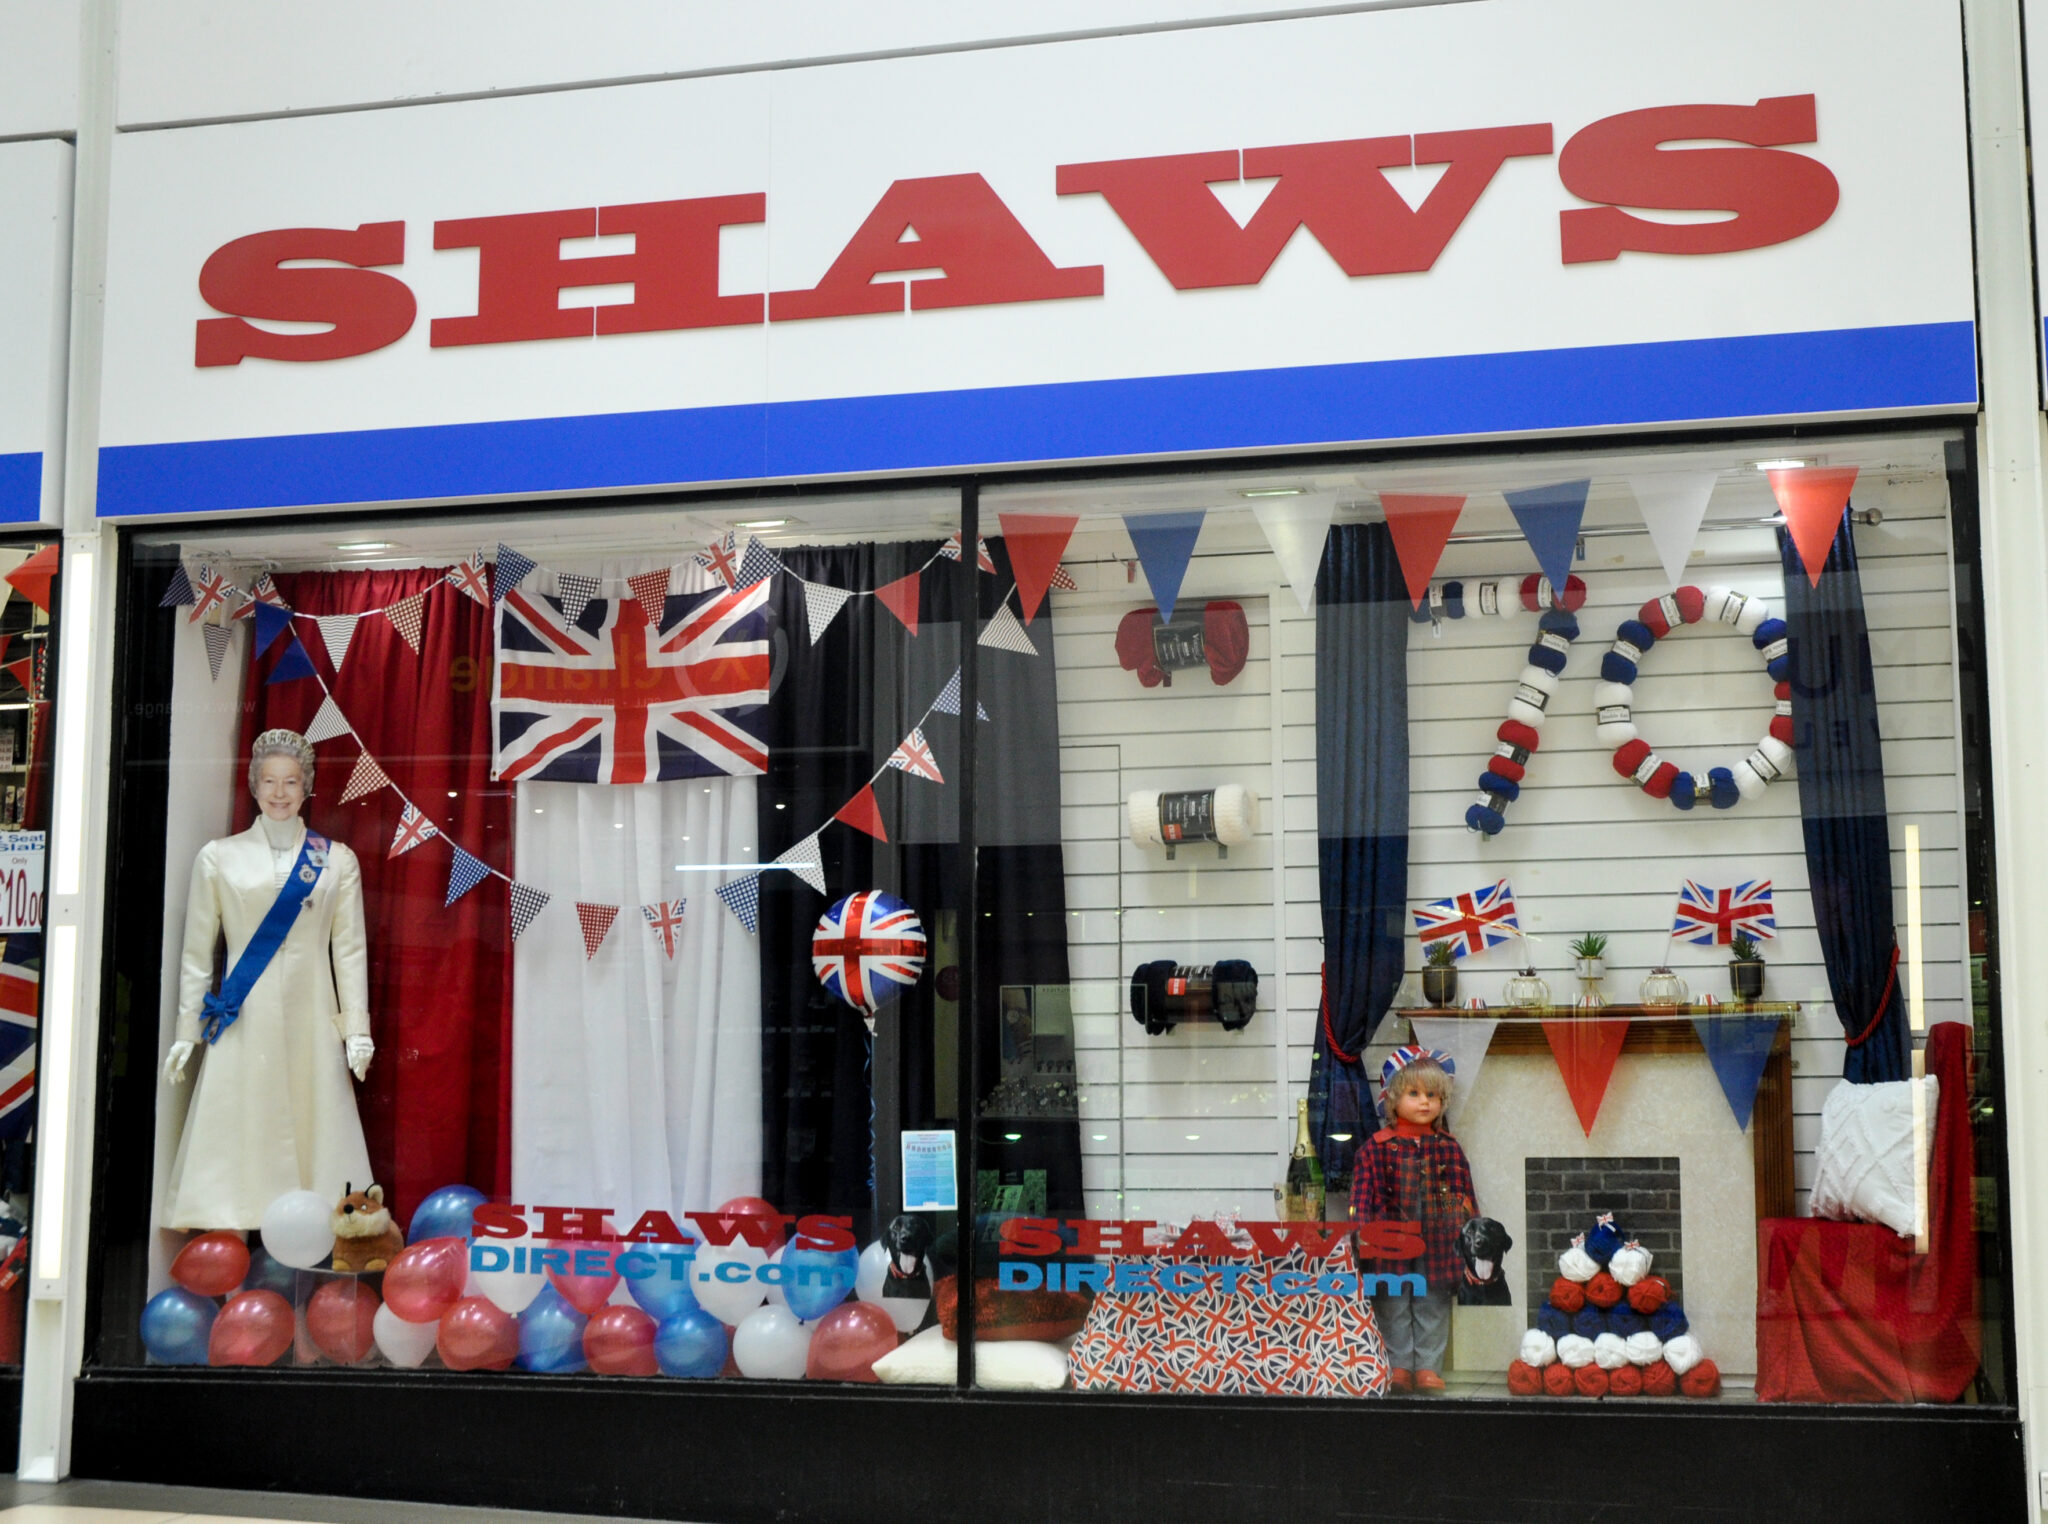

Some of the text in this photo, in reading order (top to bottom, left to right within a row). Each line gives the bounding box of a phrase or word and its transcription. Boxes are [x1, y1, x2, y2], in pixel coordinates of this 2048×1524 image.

[195, 93, 1840, 368] SHAWS
[9, 834, 43, 842] Seat
[471, 1203, 858, 1253] SHAWS
[999, 1216, 1427, 1261] SHAWS
[470, 1244, 856, 1289] DIRECT.com
[998, 1261, 1428, 1298] DIRECT.com
